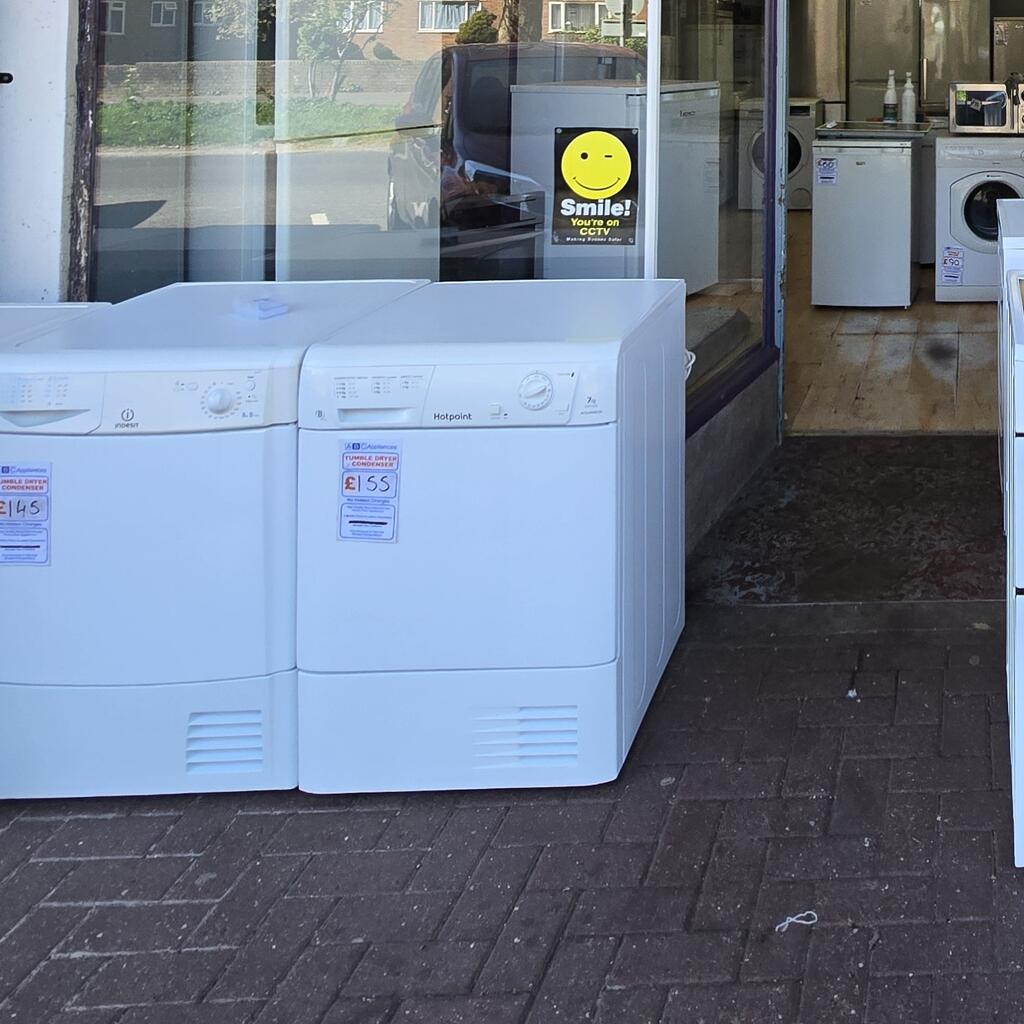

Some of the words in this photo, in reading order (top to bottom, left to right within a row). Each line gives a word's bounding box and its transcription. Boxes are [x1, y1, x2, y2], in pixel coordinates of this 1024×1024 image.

[560, 198, 632, 216] Smile!
[571, 218, 604, 226] You're
[606, 219, 620, 227] on
[579, 227, 611, 236] CCTV
[433, 412, 473, 422] Hotpoint
[344, 475, 390, 492] £155
